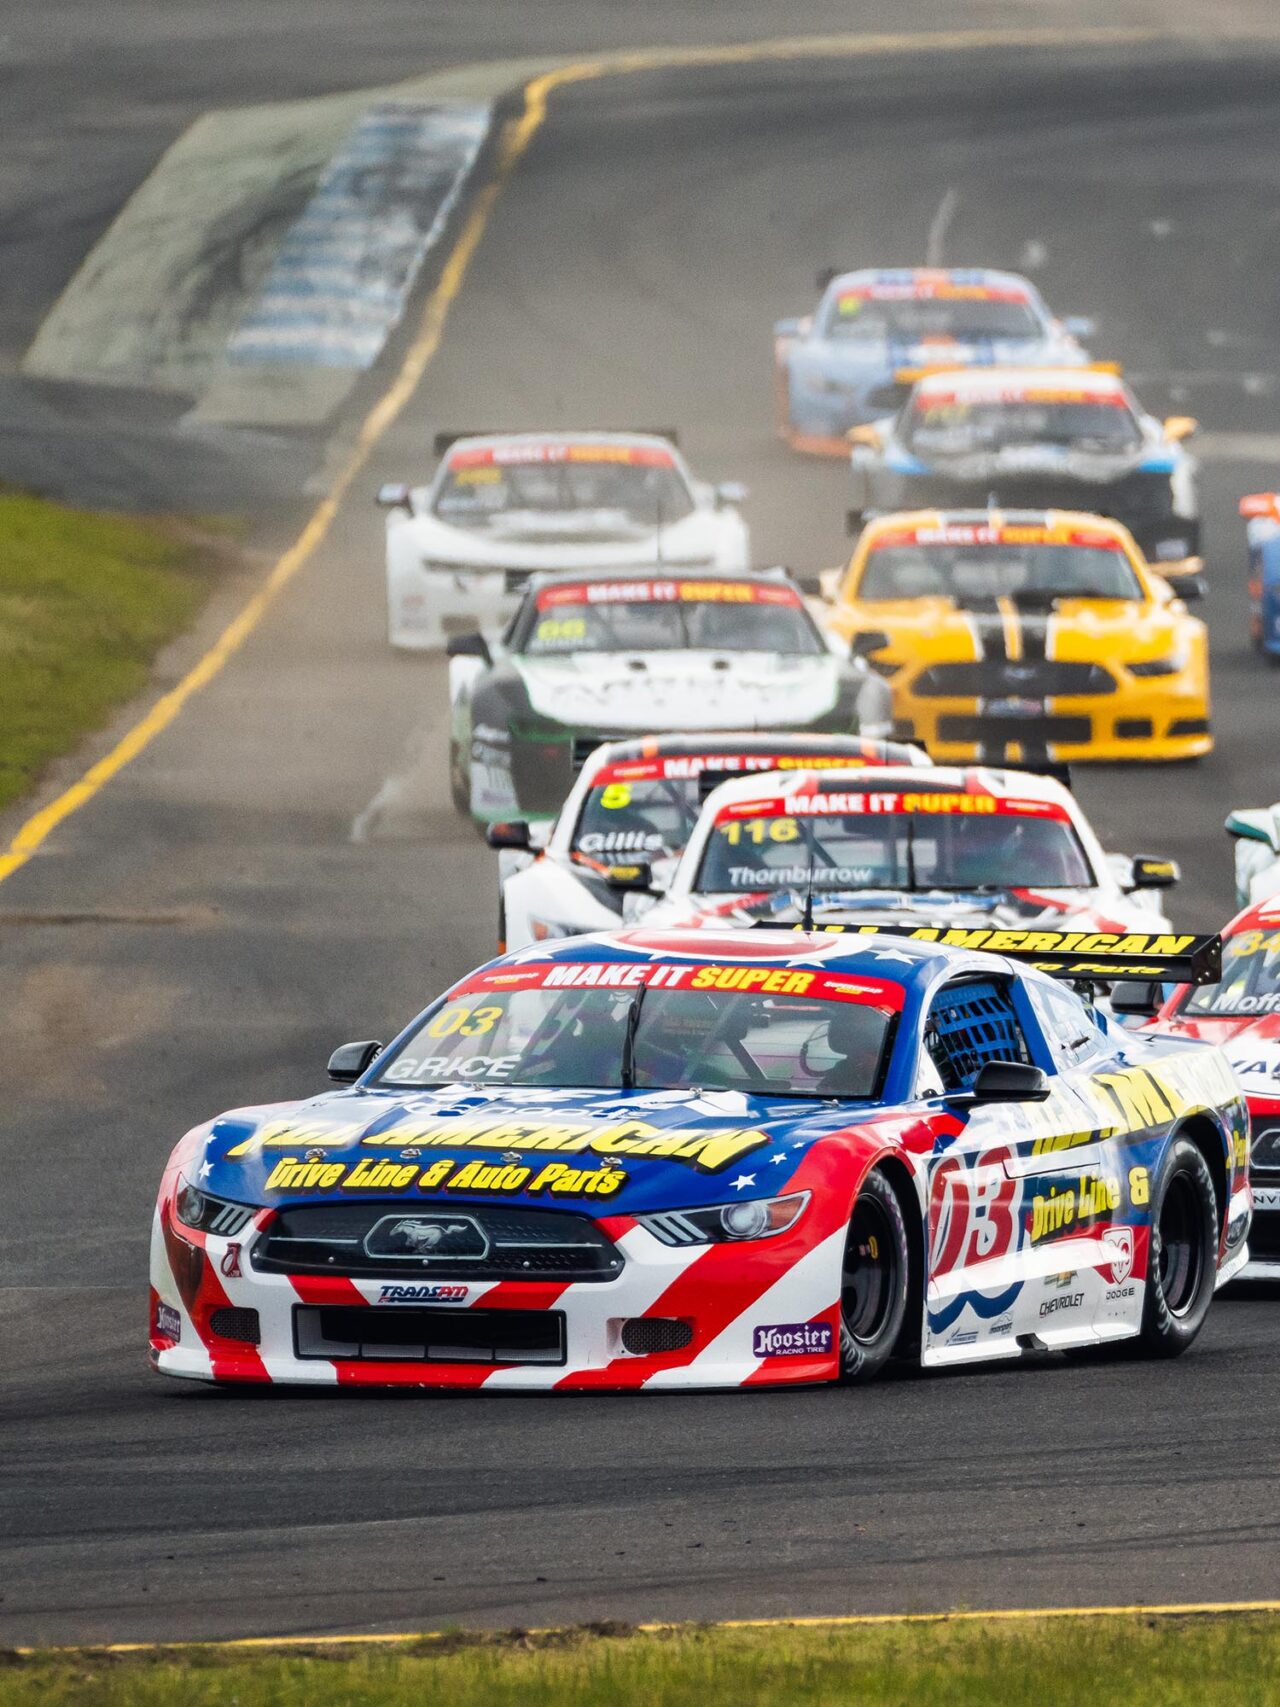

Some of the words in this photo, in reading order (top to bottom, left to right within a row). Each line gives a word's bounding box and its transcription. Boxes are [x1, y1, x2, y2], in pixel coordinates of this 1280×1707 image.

[600, 782, 632, 809] 5
[785, 793, 865, 814] MAKE
[869, 793, 898, 812] IT
[903, 793, 997, 814] SUPER
[720, 818, 798, 846] 116
[728, 866, 871, 886] Thornburrow
[910, 927, 1196, 955] AMERICAN
[541, 965, 650, 987] MAKE
[648, 966, 693, 987] IT
[690, 967, 816, 994] SUPER
[428, 1006, 504, 1039] 03
[383, 1054, 522, 1080] GRICE
[264, 1157, 346, 1191] Drive
[342, 1158, 420, 1188] Line
[418, 1160, 455, 1187] &
[447, 1161, 532, 1190] Auto
[528, 1163, 628, 1195] Parts
[1031, 1186, 1076, 1243] Drive
[1077, 1171, 1122, 1218] Line
[1128, 1167, 1150, 1206] &
[1038, 1292, 1087, 1319] CHEVROLET
[1105, 1287, 1137, 1301] DODGE
[755, 1325, 831, 1353] Hoosier
[775, 1348, 804, 1356] RACING
